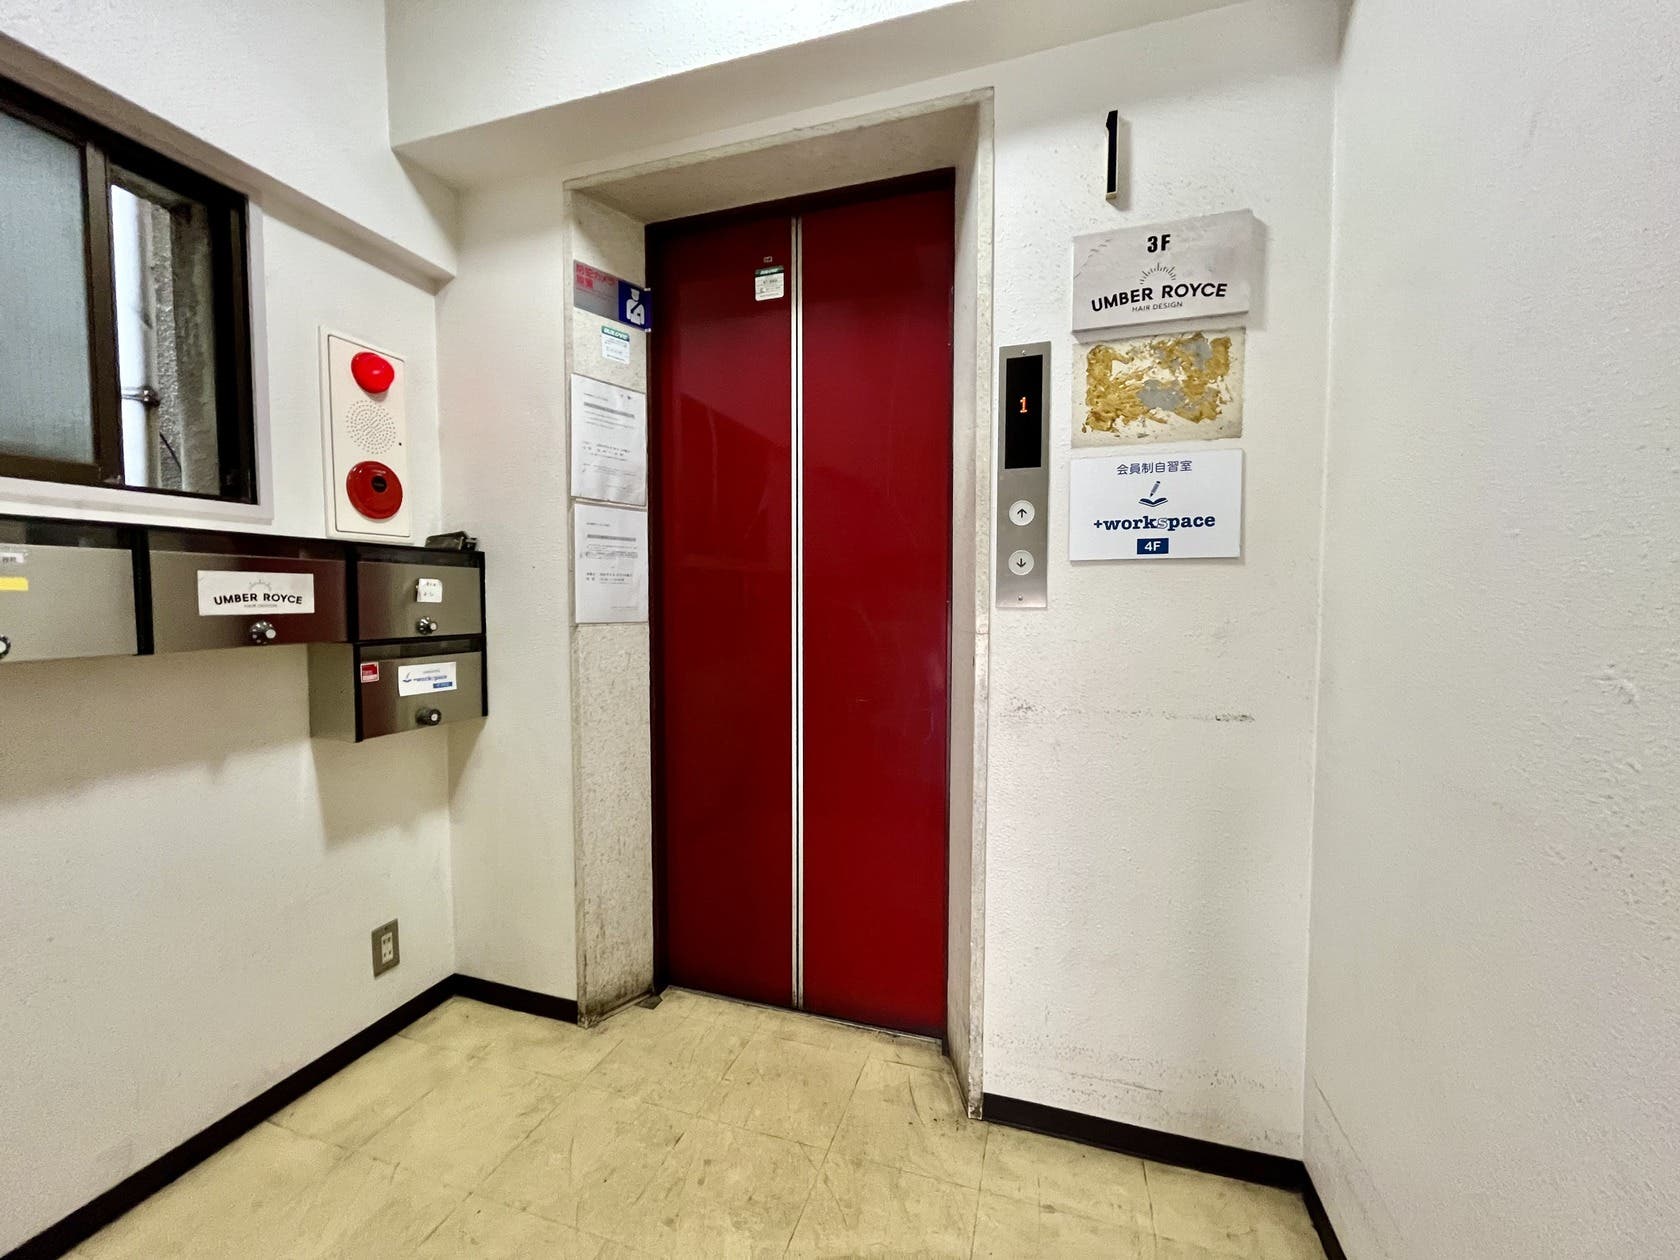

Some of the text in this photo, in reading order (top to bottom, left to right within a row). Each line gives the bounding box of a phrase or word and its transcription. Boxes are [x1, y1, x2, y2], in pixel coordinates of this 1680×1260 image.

[1106, 110, 1118, 197] 1
[1146, 233, 1171, 253] 3F
[1091, 282, 1228, 312] UMBER ROYCE
[1152, 301, 1183, 310] DESIGN
[1018, 396, 1028, 413] 1
[1117, 460, 1193, 475] 会員制自習室
[1094, 516, 1216, 532] +workspace
[1144, 541, 1161, 552] 4F
[213, 593, 258, 606] UMBER
[263, 593, 303, 605] ROYCE
